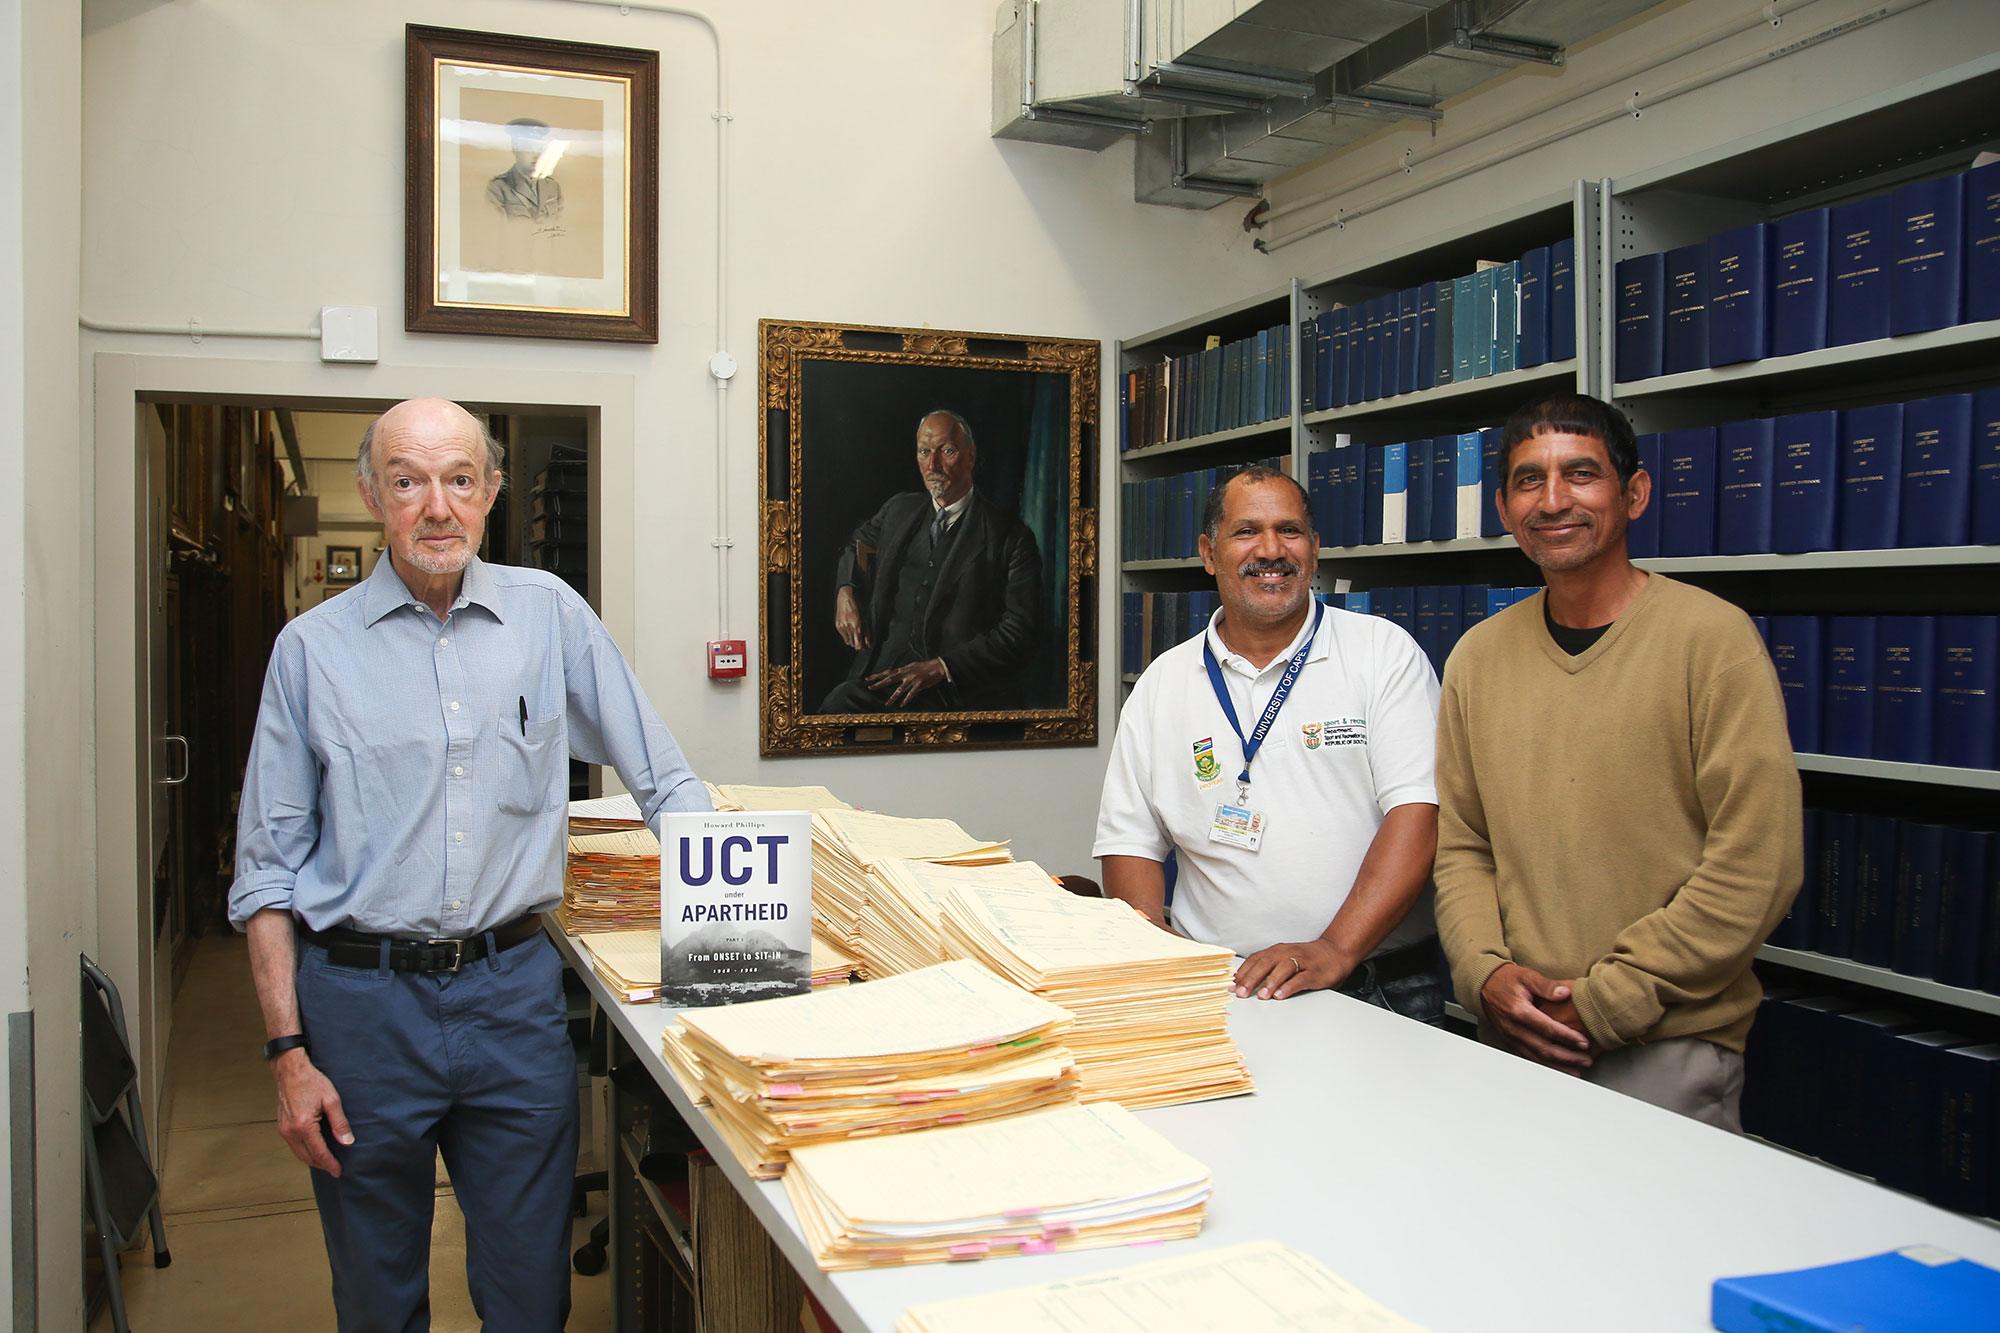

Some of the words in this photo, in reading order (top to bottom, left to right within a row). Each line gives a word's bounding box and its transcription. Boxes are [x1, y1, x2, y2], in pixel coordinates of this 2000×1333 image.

[1254, 685, 1288, 741] UNIVERSITY
[1282, 672, 1294, 688] OF
[1289, 651, 1307, 674] CAPE
[736, 822, 765, 830] Phillips
[680, 835, 789, 886] UCT
[681, 903, 788, 922] APARTHEID
[688, 953, 710, 962] From
[713, 952, 740, 961] ONSET
[743, 952, 752, 961] to
[754, 951, 781, 960] SIT-IN
